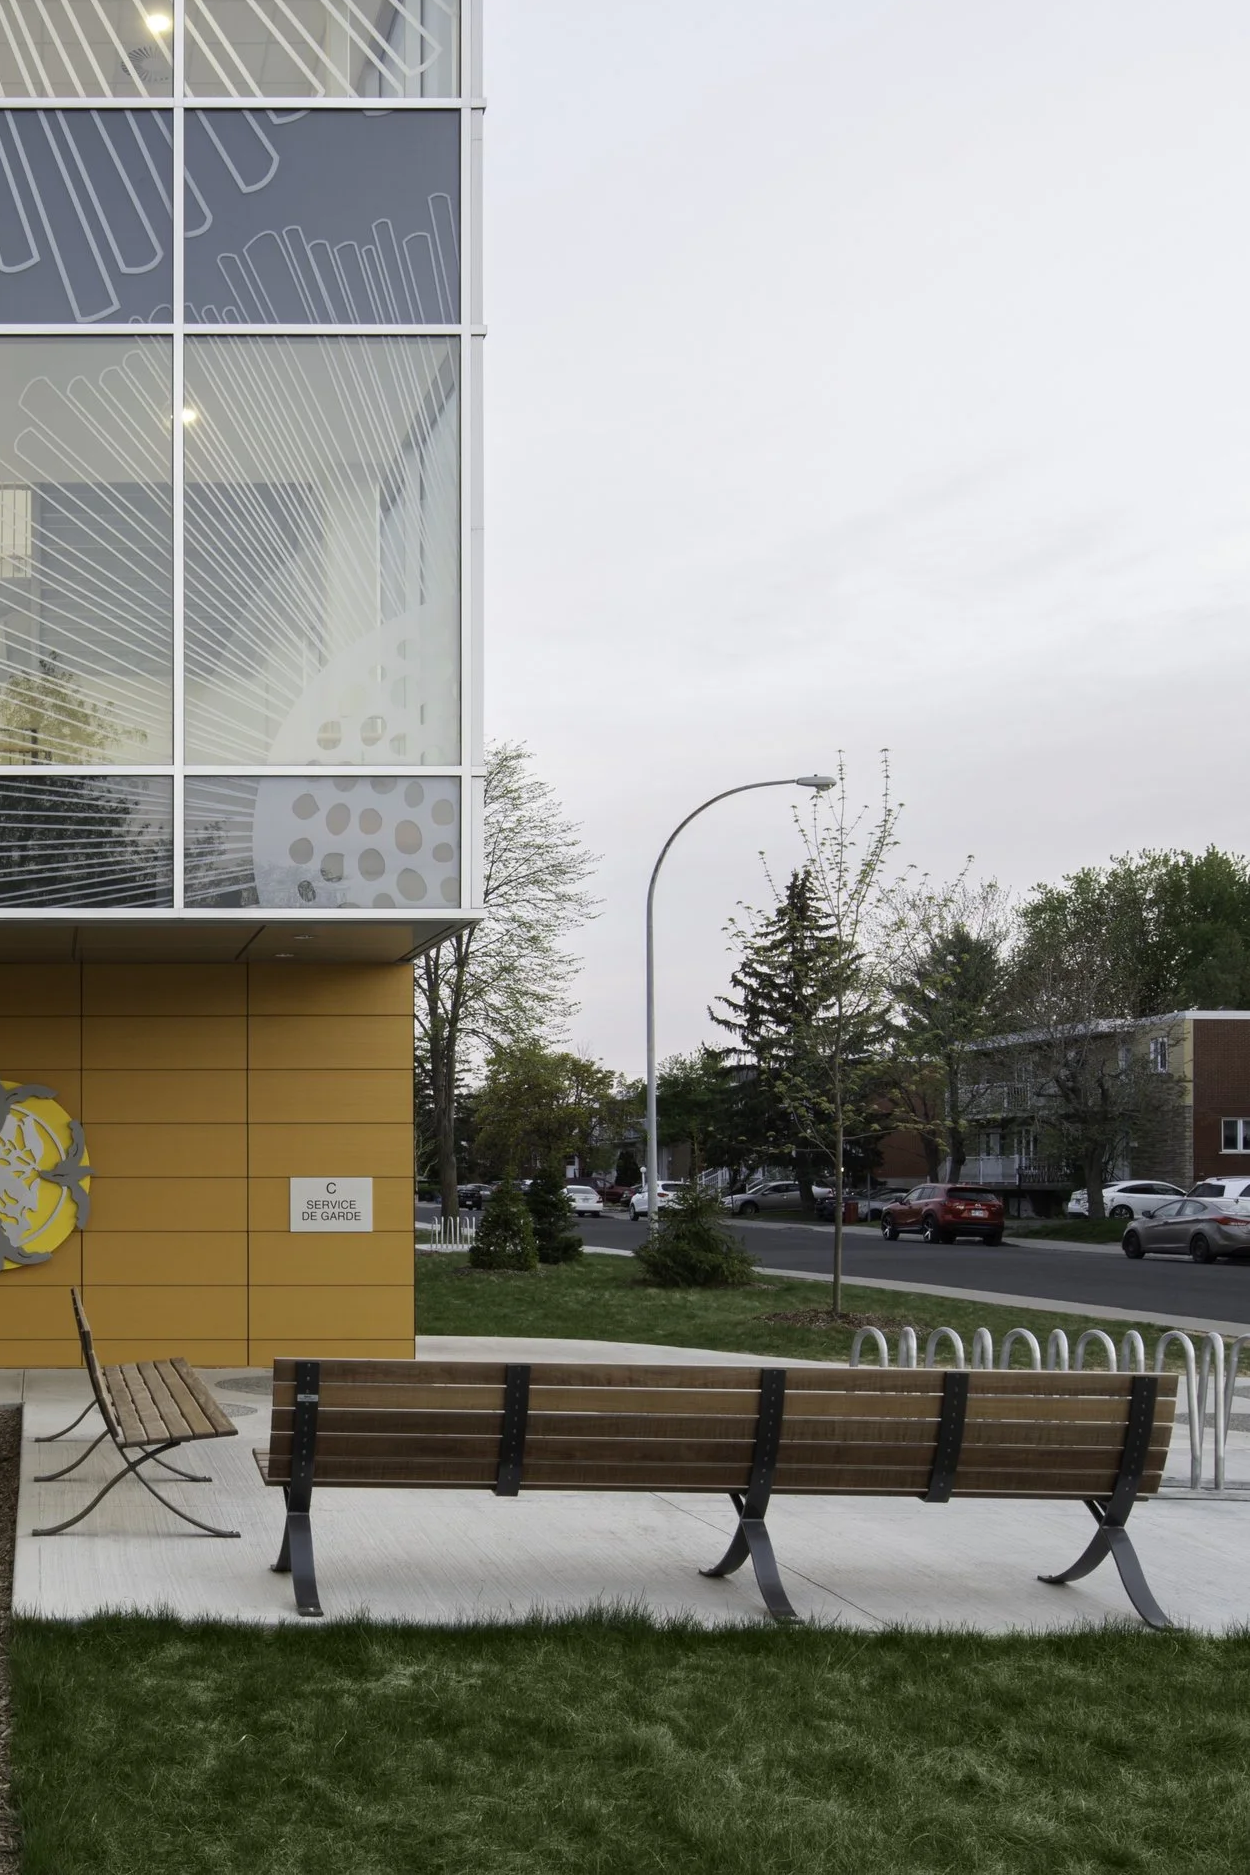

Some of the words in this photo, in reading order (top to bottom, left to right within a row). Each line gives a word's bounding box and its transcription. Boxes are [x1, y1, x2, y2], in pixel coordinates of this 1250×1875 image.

[326, 1182, 337, 1194] C
[306, 1200, 356, 1210] SERVICE
[301, 1211, 317, 1221] DE
[321, 1211, 361, 1221] GARDE
